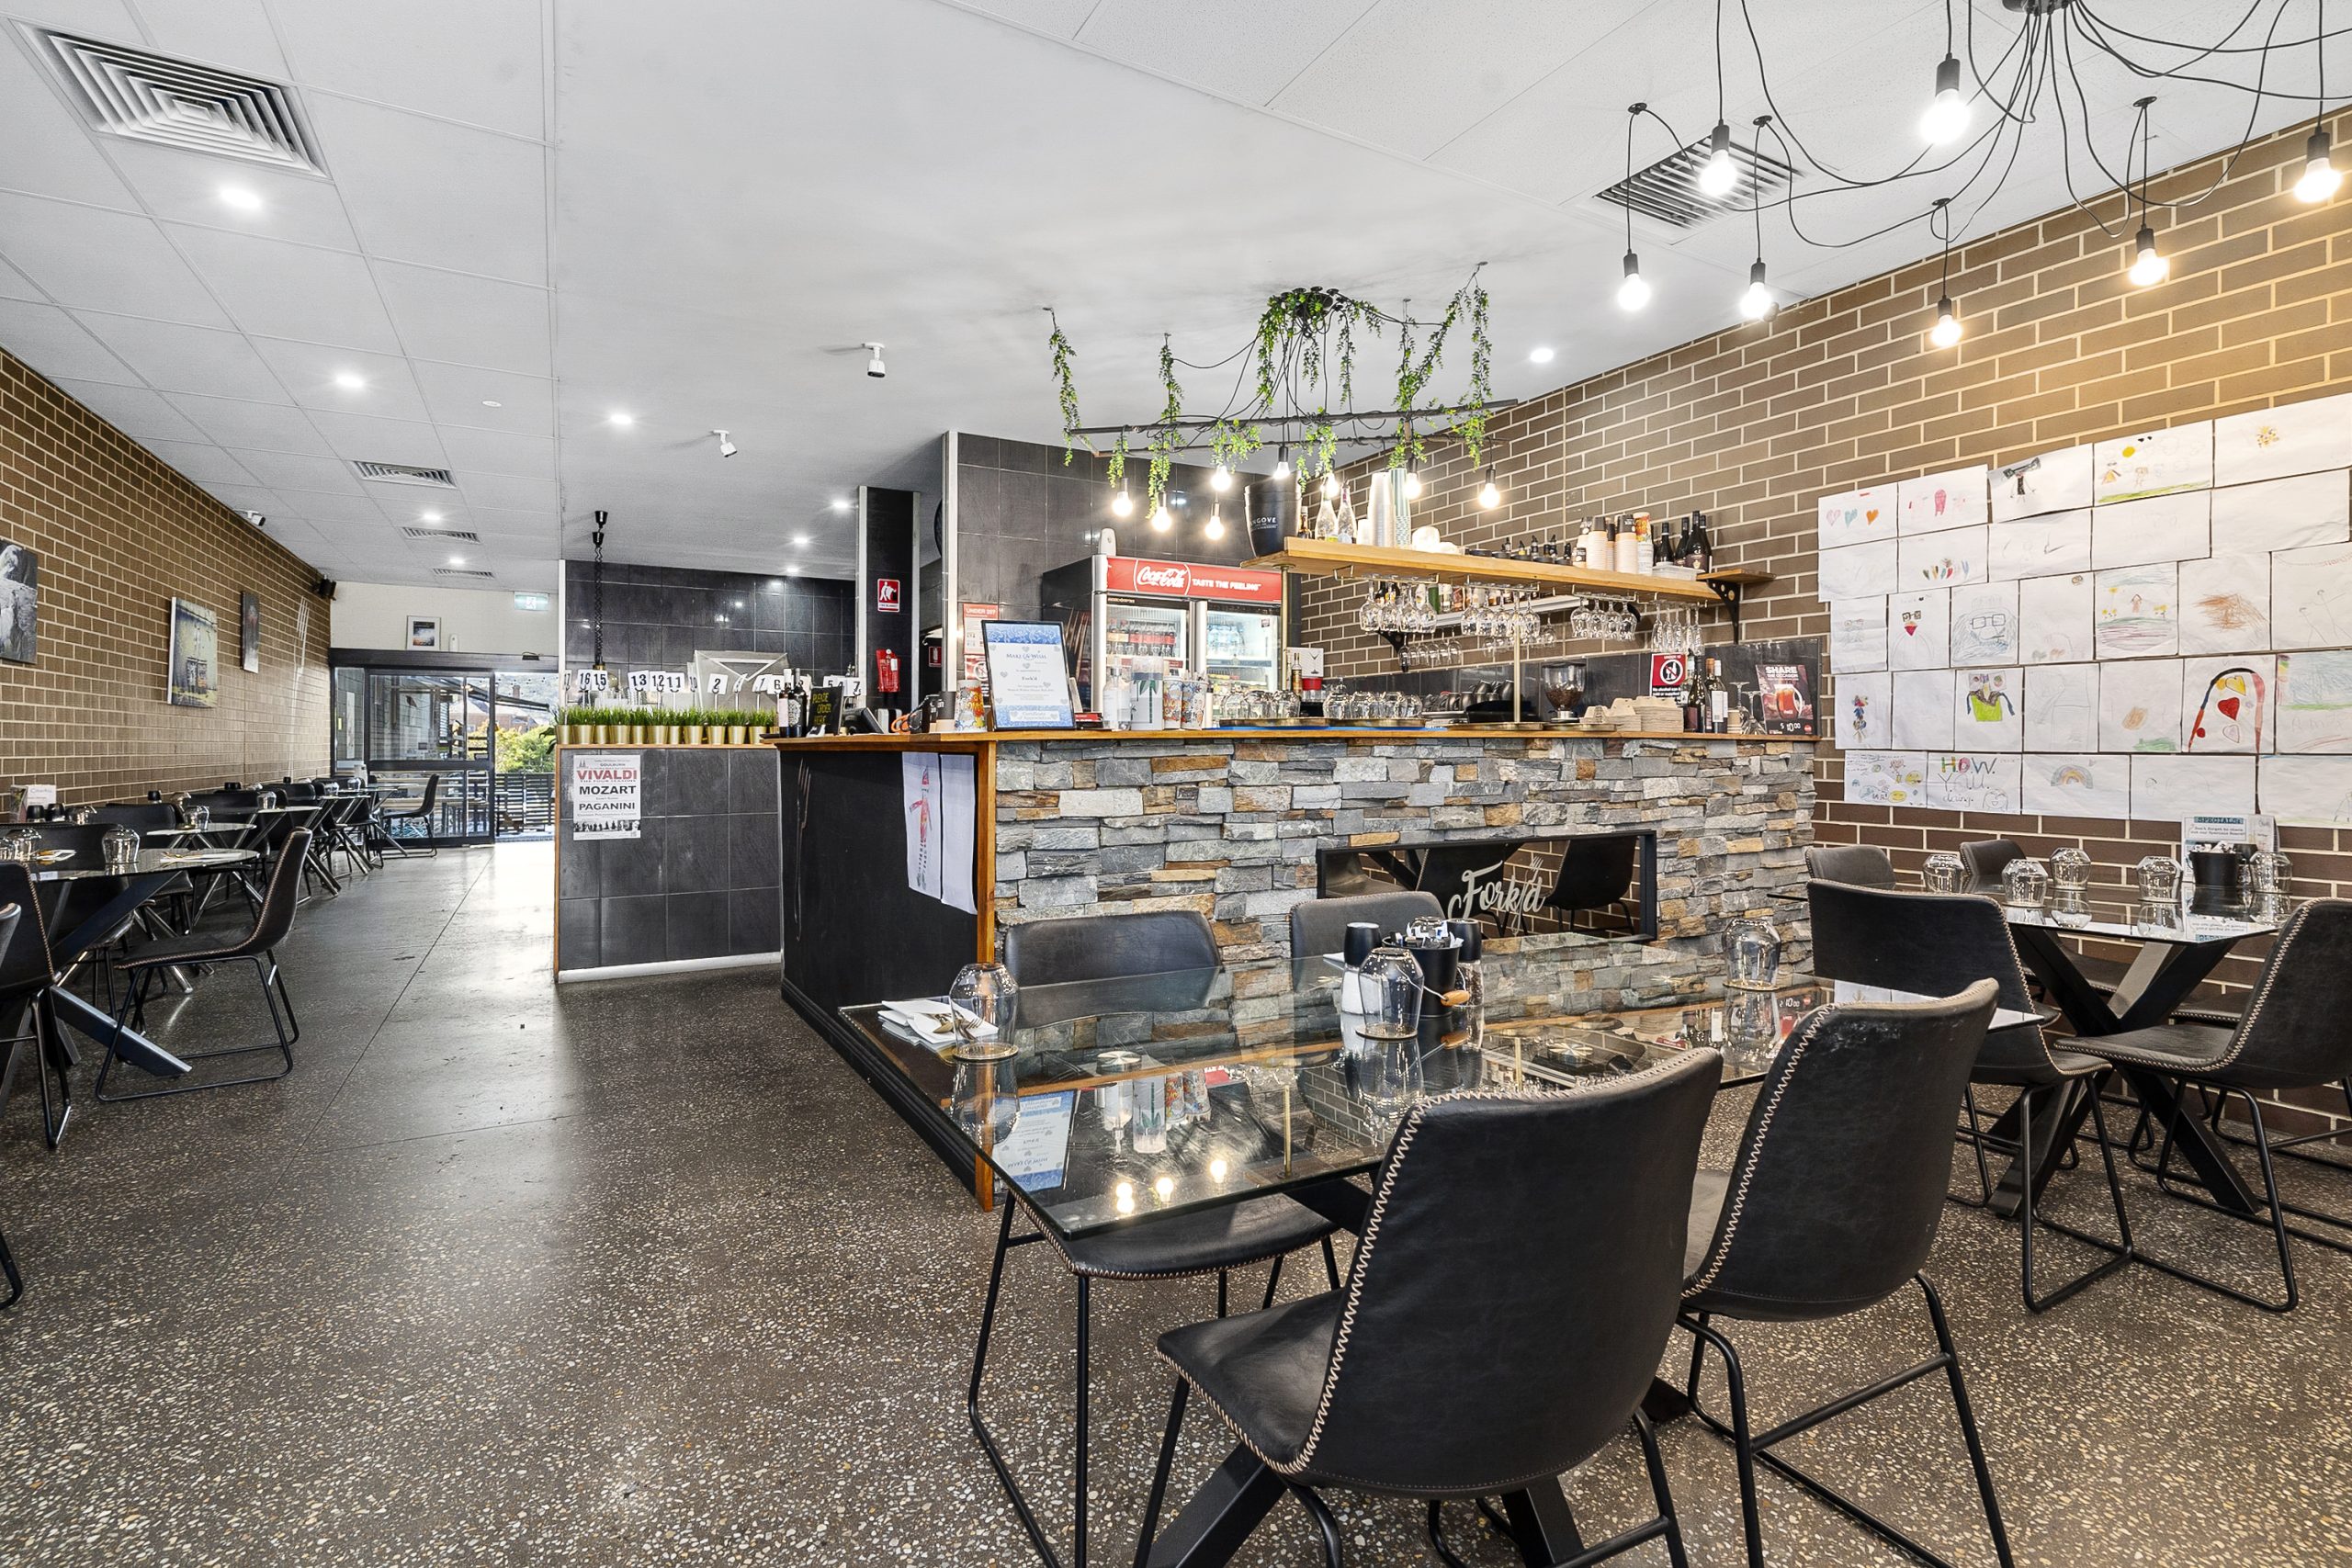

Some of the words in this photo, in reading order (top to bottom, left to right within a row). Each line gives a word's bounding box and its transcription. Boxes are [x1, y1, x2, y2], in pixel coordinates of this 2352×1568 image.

[1136, 566, 1188, 589] Coca-Cola
[1192, 578, 1215, 588] TASTE
[1216, 581, 1229, 590] THE
[1765, 666, 1798, 674] SHARE
[580, 672, 591, 685] 16
[594, 673, 607, 686] 15
[631, 674, 647, 686] 13
[652, 675, 664, 687] 12
[667, 676, 681, 688] 11
[714, 678, 720, 690] 2
[774, 680, 781, 690] 6
[854, 682, 861, 692] 7
[576, 770, 638, 780] VIVALDI
[579, 785, 637, 795] MOZART
[579, 802, 636, 811] PAGANINI
